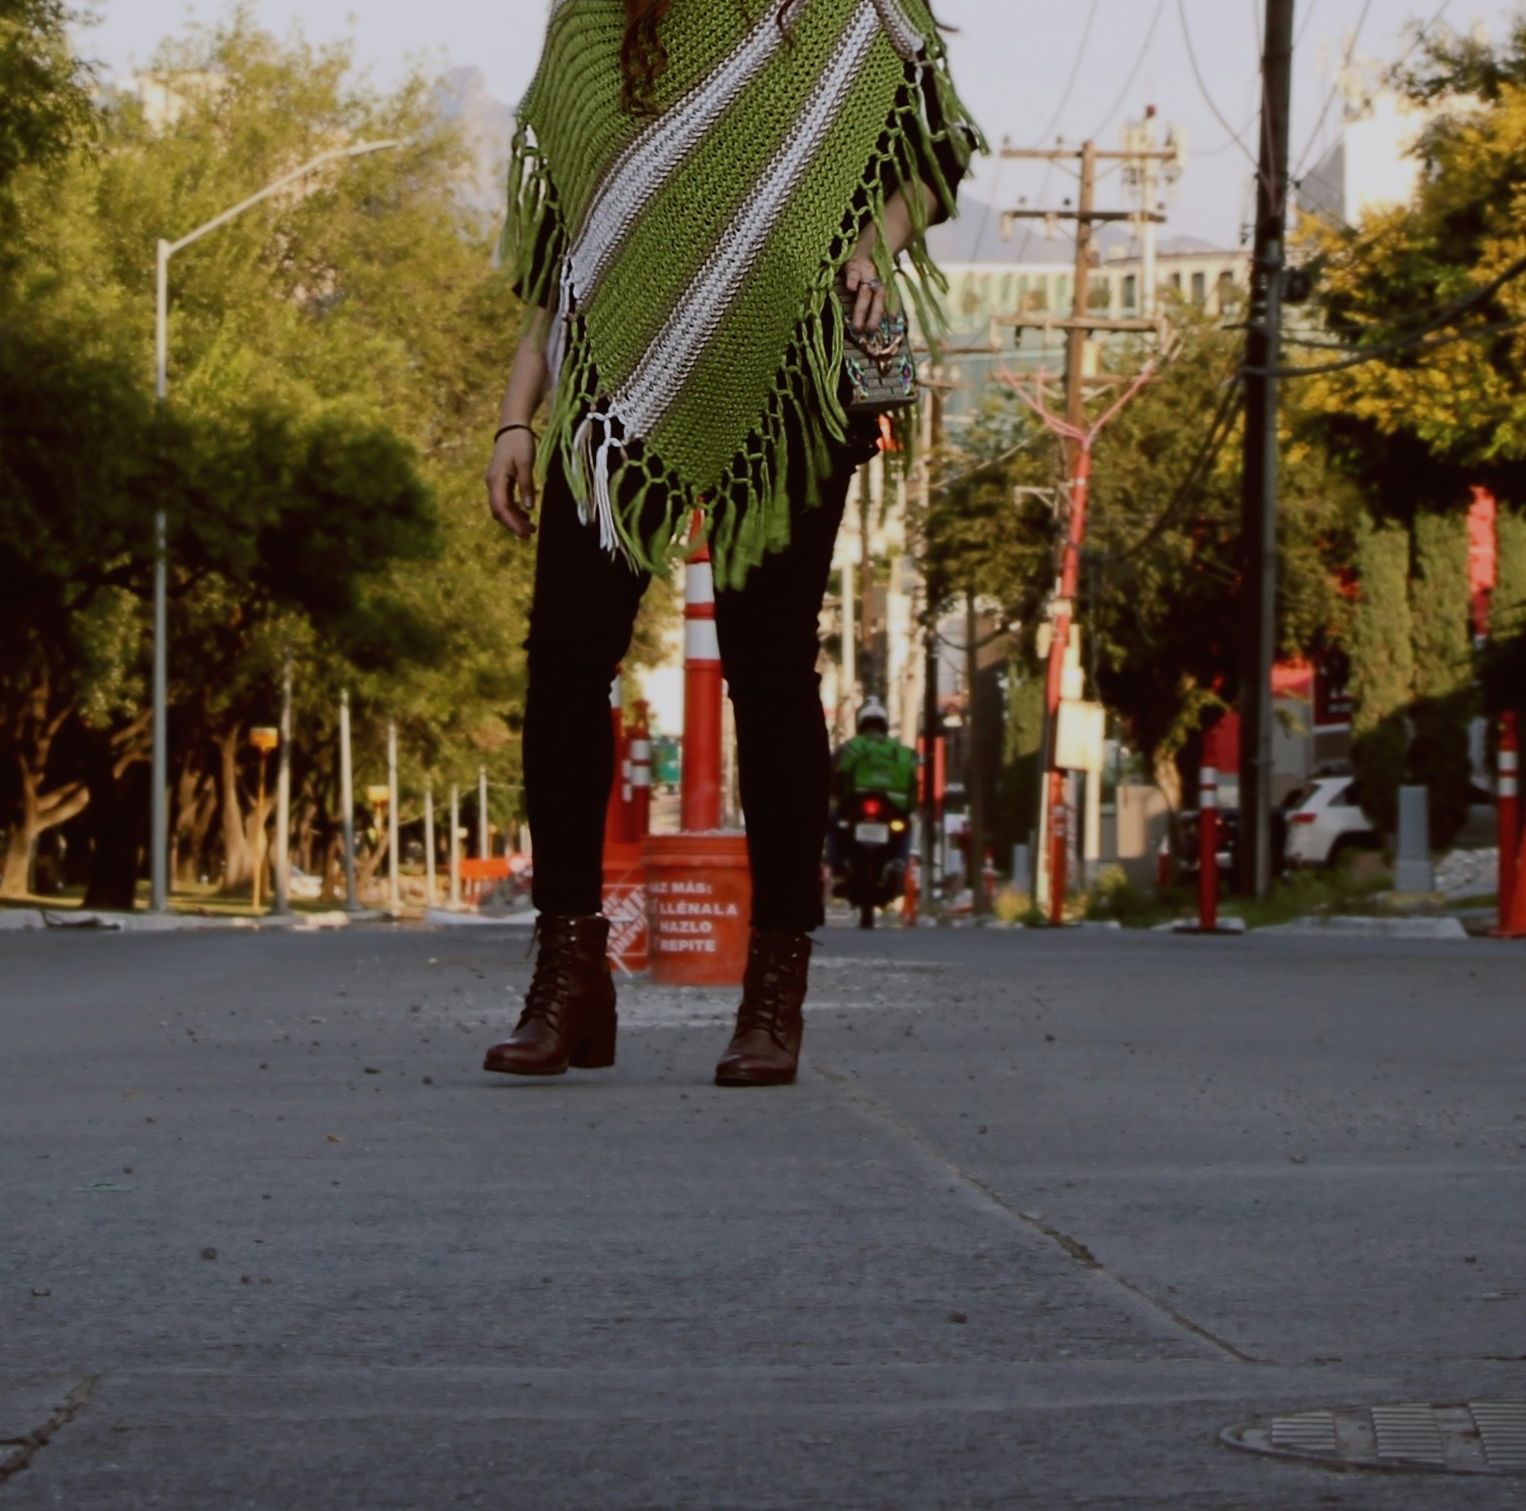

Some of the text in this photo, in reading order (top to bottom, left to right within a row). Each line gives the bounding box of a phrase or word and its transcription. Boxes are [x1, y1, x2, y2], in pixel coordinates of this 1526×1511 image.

[671, 879, 713, 894] MÁS:
[659, 899, 738, 916] LLÉNALA
[659, 919, 713, 933] HAZLO
[659, 939, 717, 952] REPITE
